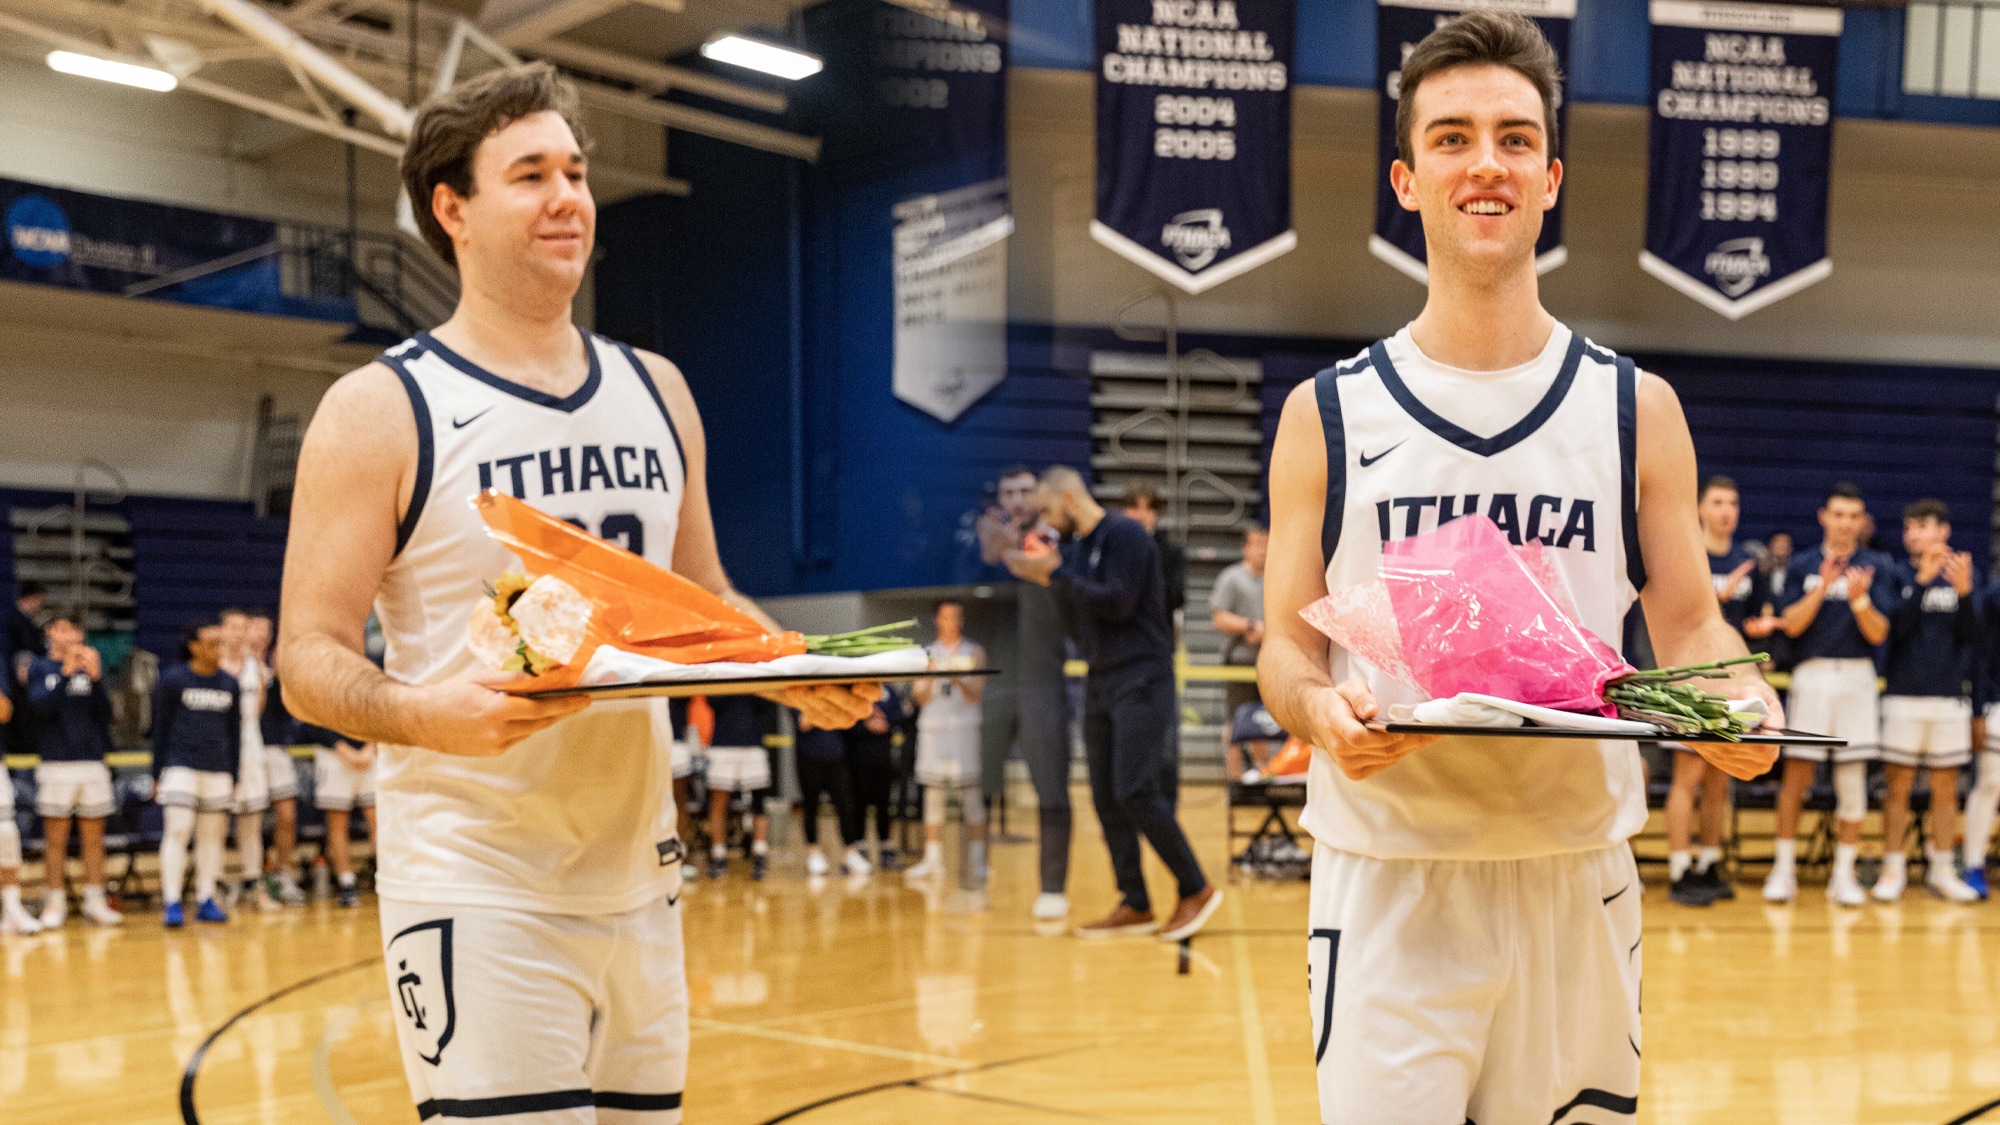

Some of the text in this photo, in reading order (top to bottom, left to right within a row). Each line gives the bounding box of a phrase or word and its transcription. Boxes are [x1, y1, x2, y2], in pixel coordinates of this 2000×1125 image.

[1153, 1, 1239, 29] NCAA
[1117, 24, 1274, 61] NATIONAL
[1704, 34, 1786, 64] NCAA
[1103, 53, 1287, 91] CHAMPIONS
[1671, 61, 1818, 96] NATIONAL
[1154, 94, 1236, 127] 2004
[1657, 89, 1830, 126] CHAMPIONS
[1154, 128, 1236, 160] 2005
[1701, 192, 1778, 222] 1994
[477, 445, 670, 502] ITHACA
[1375, 493, 1597, 554] ITHACA
